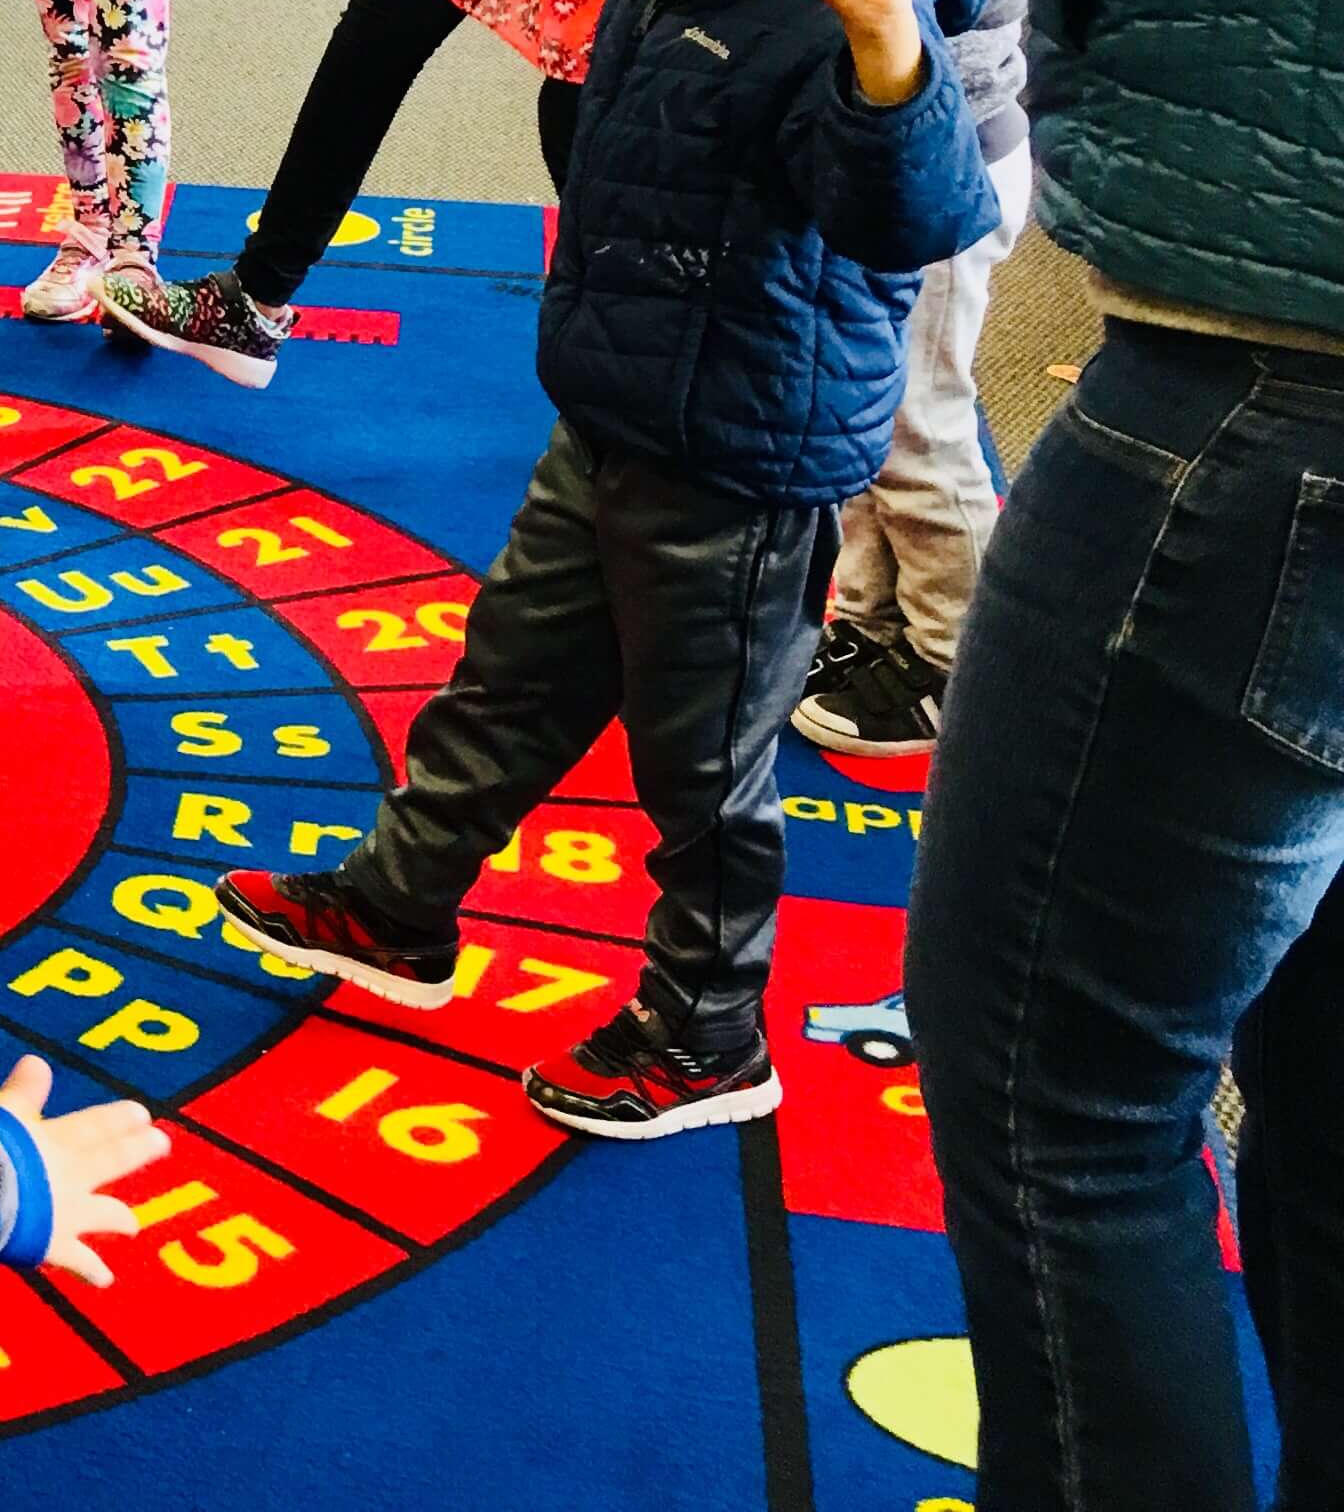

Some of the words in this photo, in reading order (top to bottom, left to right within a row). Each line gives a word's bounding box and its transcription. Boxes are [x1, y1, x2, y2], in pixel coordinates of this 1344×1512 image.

[387, 207, 436, 257] circle
[70, 447, 208, 501] 22
[217, 516, 354, 567] 21
[451, 943, 610, 1013] 17
[314, 1067, 491, 1164] 16
[132, 1180, 296, 1289] 15
